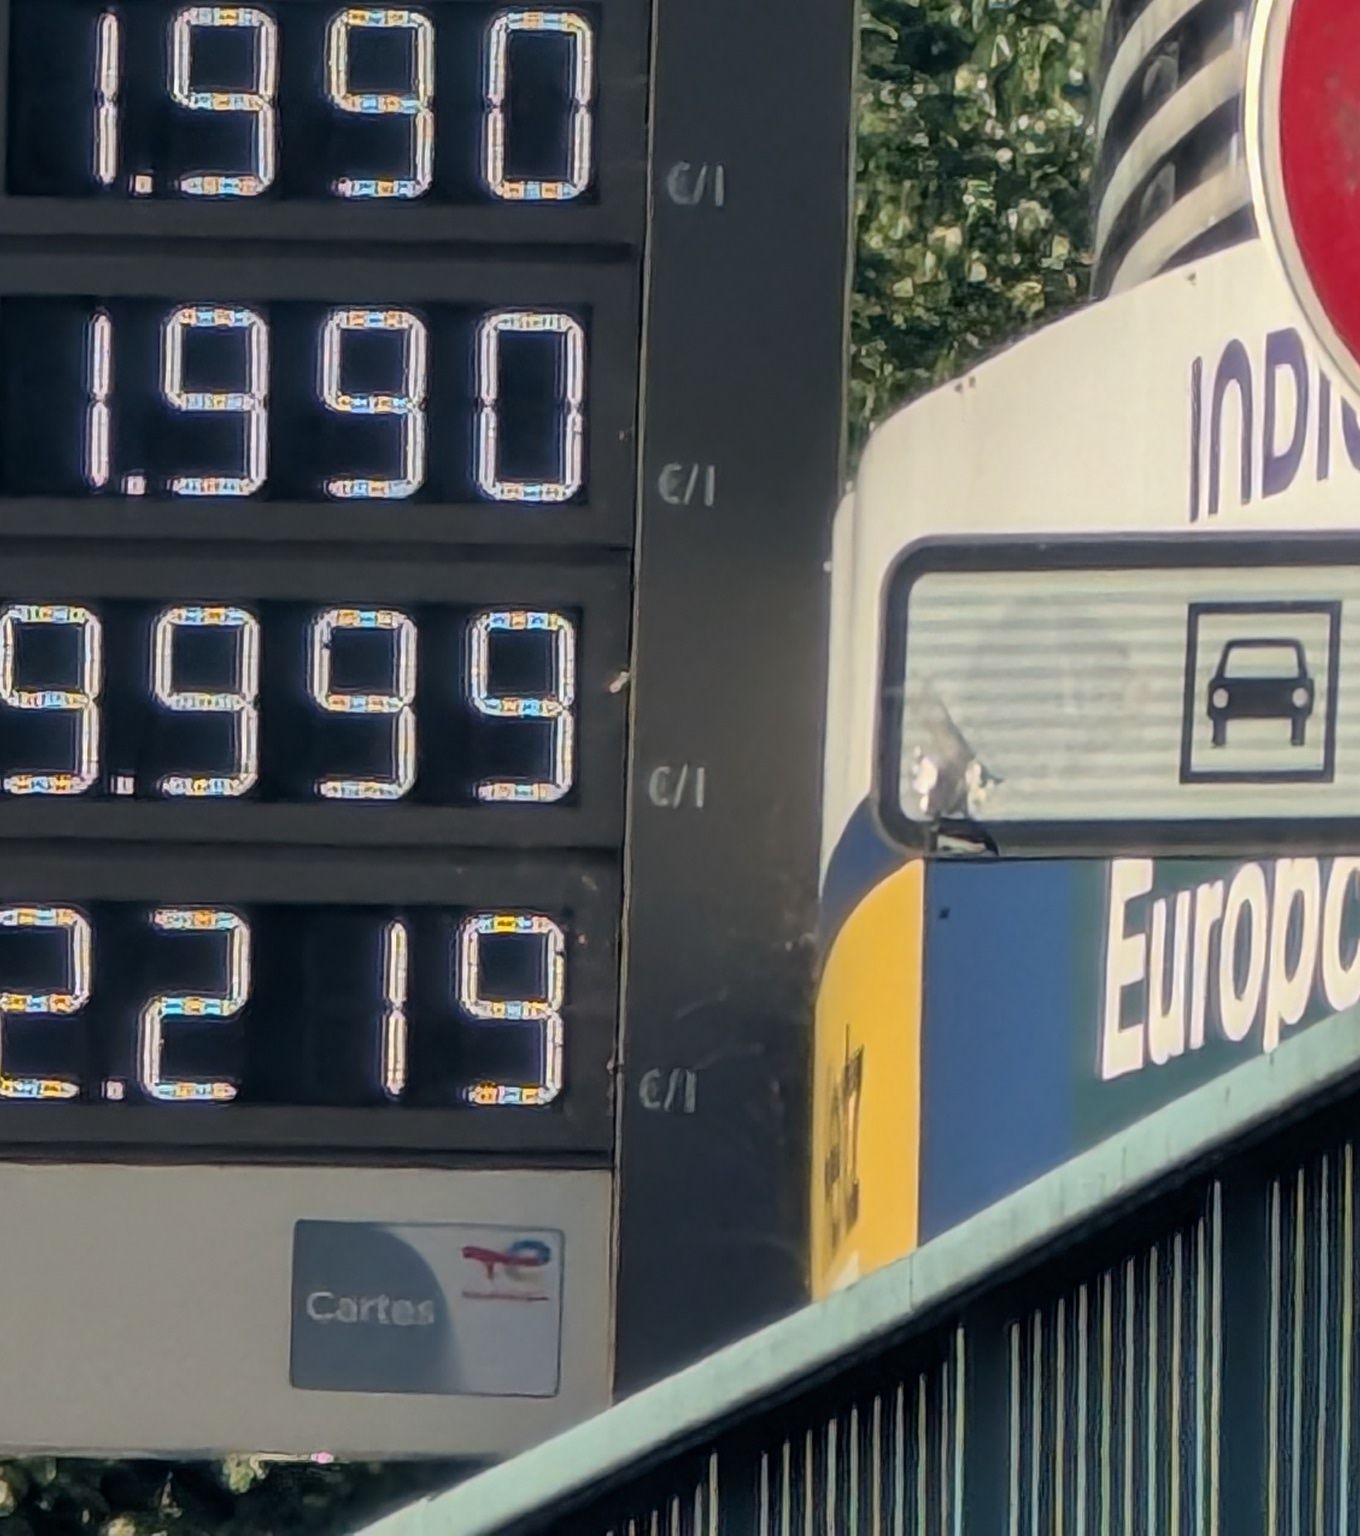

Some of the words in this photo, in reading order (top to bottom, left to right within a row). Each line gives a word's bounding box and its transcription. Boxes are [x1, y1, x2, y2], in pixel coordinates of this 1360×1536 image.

[94, 7, 593, 201] 1.990
[87, 305, 586, 502] 1.990
[305, 1290, 436, 1327] Cartes
